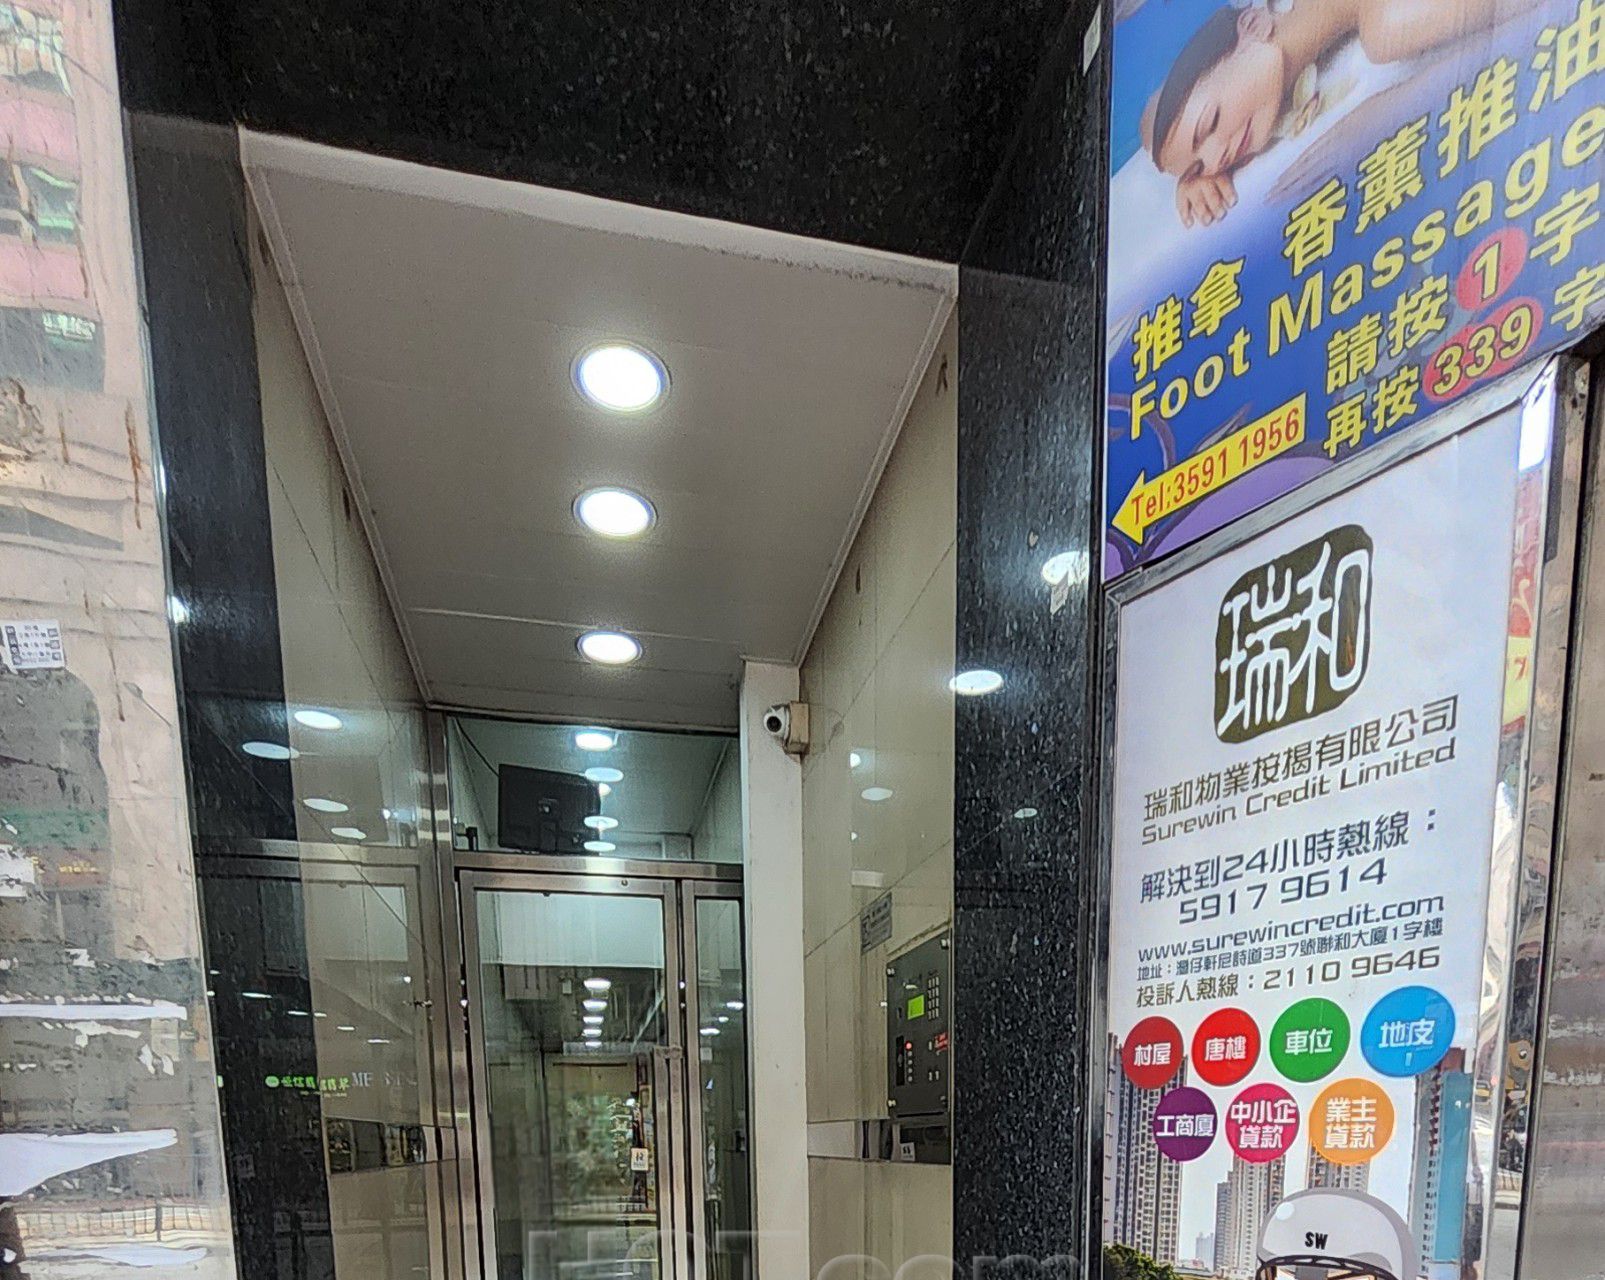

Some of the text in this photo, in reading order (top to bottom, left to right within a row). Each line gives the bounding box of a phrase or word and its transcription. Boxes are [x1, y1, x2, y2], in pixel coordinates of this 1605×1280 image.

[1129, 103, 1605, 440] Foot Massage
[1326, 180, 1601, 396] 請按 1 字
[1132, 257, 1245, 382] 推拿
[1324, 365, 1419, 459] 再按
[1433, 305, 1532, 397] 339
[1130, 407, 1300, 526] Tel:3591 1956
[1217, 541, 1371, 736] 瑞和
[1143, 694, 1459, 823] 瑞和物業按揭有限公司
[1142, 738, 1457, 846] Surewin Credit Limited
[1179, 858, 1387, 925] 5917 9614
[1138, 895, 1445, 962] www.surewincredit.com
[1352, 948, 1440, 978] 9646
[1133, 1044, 1172, 1067] 村屋
[1204, 1037, 1248, 1062] 唐樓
[1285, 1028, 1333, 1055] 車位
[1380, 1018, 1434, 1046] 地皮
[1231, 1099, 1297, 1125] 中小企
[1326, 1096, 1377, 1123] 業主
[1240, 1126, 1283, 1150] 貸款
[1324, 1126, 1376, 1150] 貸款
[1304, 1231, 1329, 1250] SW
